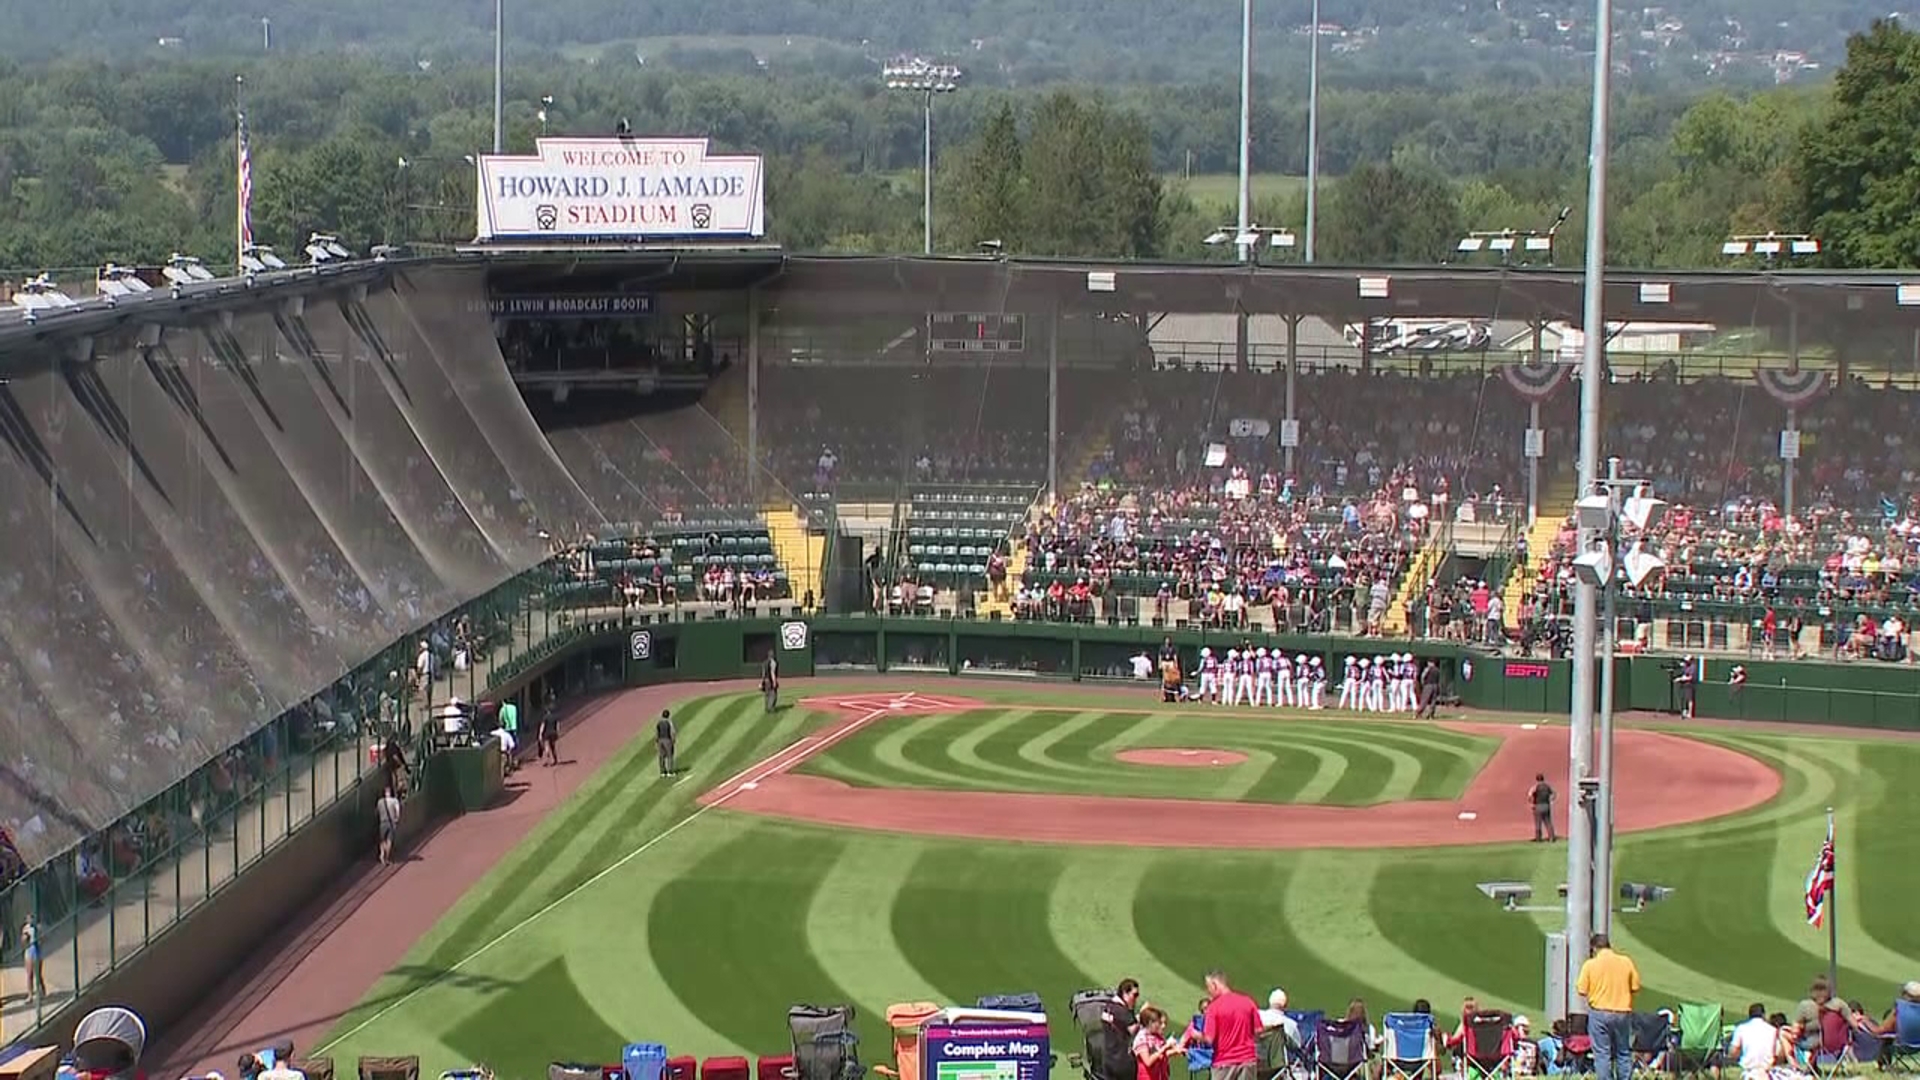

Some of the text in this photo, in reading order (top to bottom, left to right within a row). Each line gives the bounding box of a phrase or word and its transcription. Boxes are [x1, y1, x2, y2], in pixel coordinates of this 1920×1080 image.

[562, 150, 686, 166] WELCOME TO
[499, 176, 744, 198] HOWARD J. LAMADE
[567, 205, 677, 223] STADIUM
[549, 298, 609, 312] BROADCAST
[613, 297, 649, 311] BOOTH
[1504, 664, 1549, 678] ESPN
[943, 1041, 1039, 1059] Complex Map
